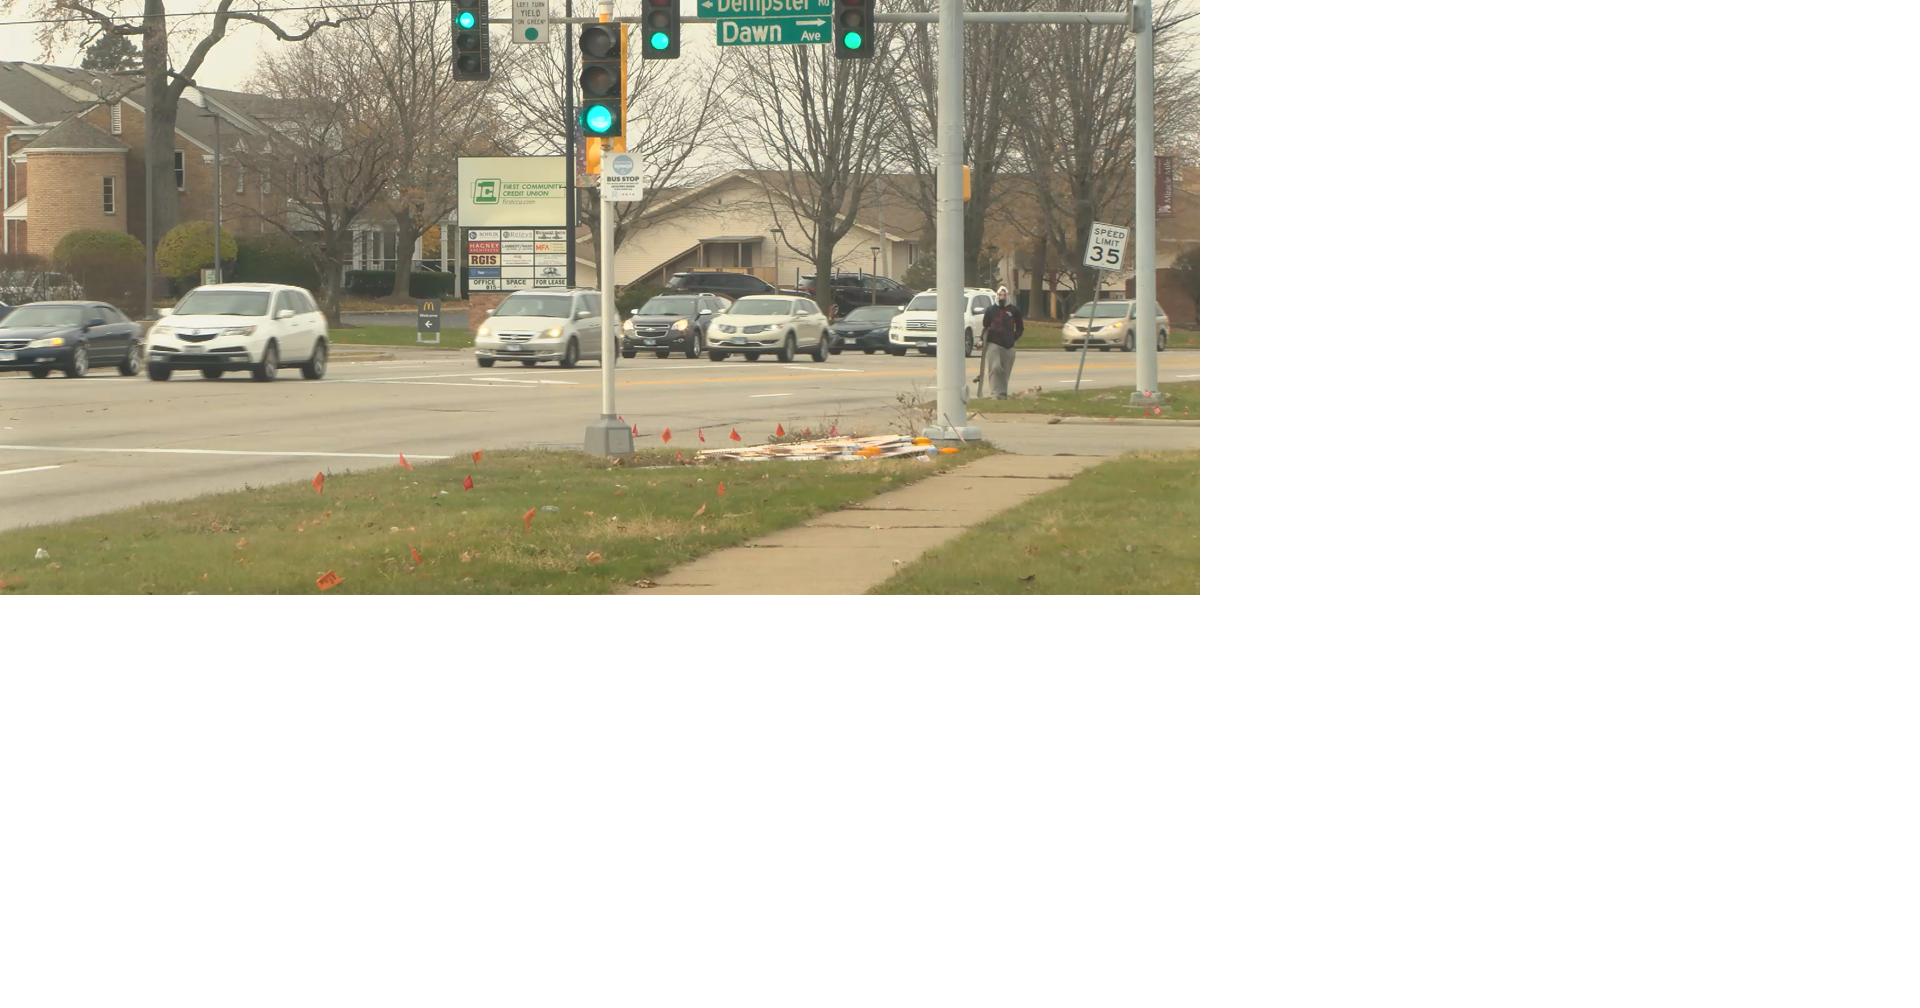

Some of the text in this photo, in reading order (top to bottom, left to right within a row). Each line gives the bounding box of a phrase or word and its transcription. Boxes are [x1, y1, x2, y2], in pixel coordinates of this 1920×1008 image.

[520, 9, 541, 17] YIELD
[717, 0, 809, 16] Dempster
[722, 21, 821, 43] Dawn Ave
[1163, 159, 1172, 204] Miracle Mile
[1094, 228, 1125, 239] SPEED
[1095, 237, 1120, 247] LIMIT
[471, 255, 497, 265] RGIS
[1090, 246, 1120, 265] 35
